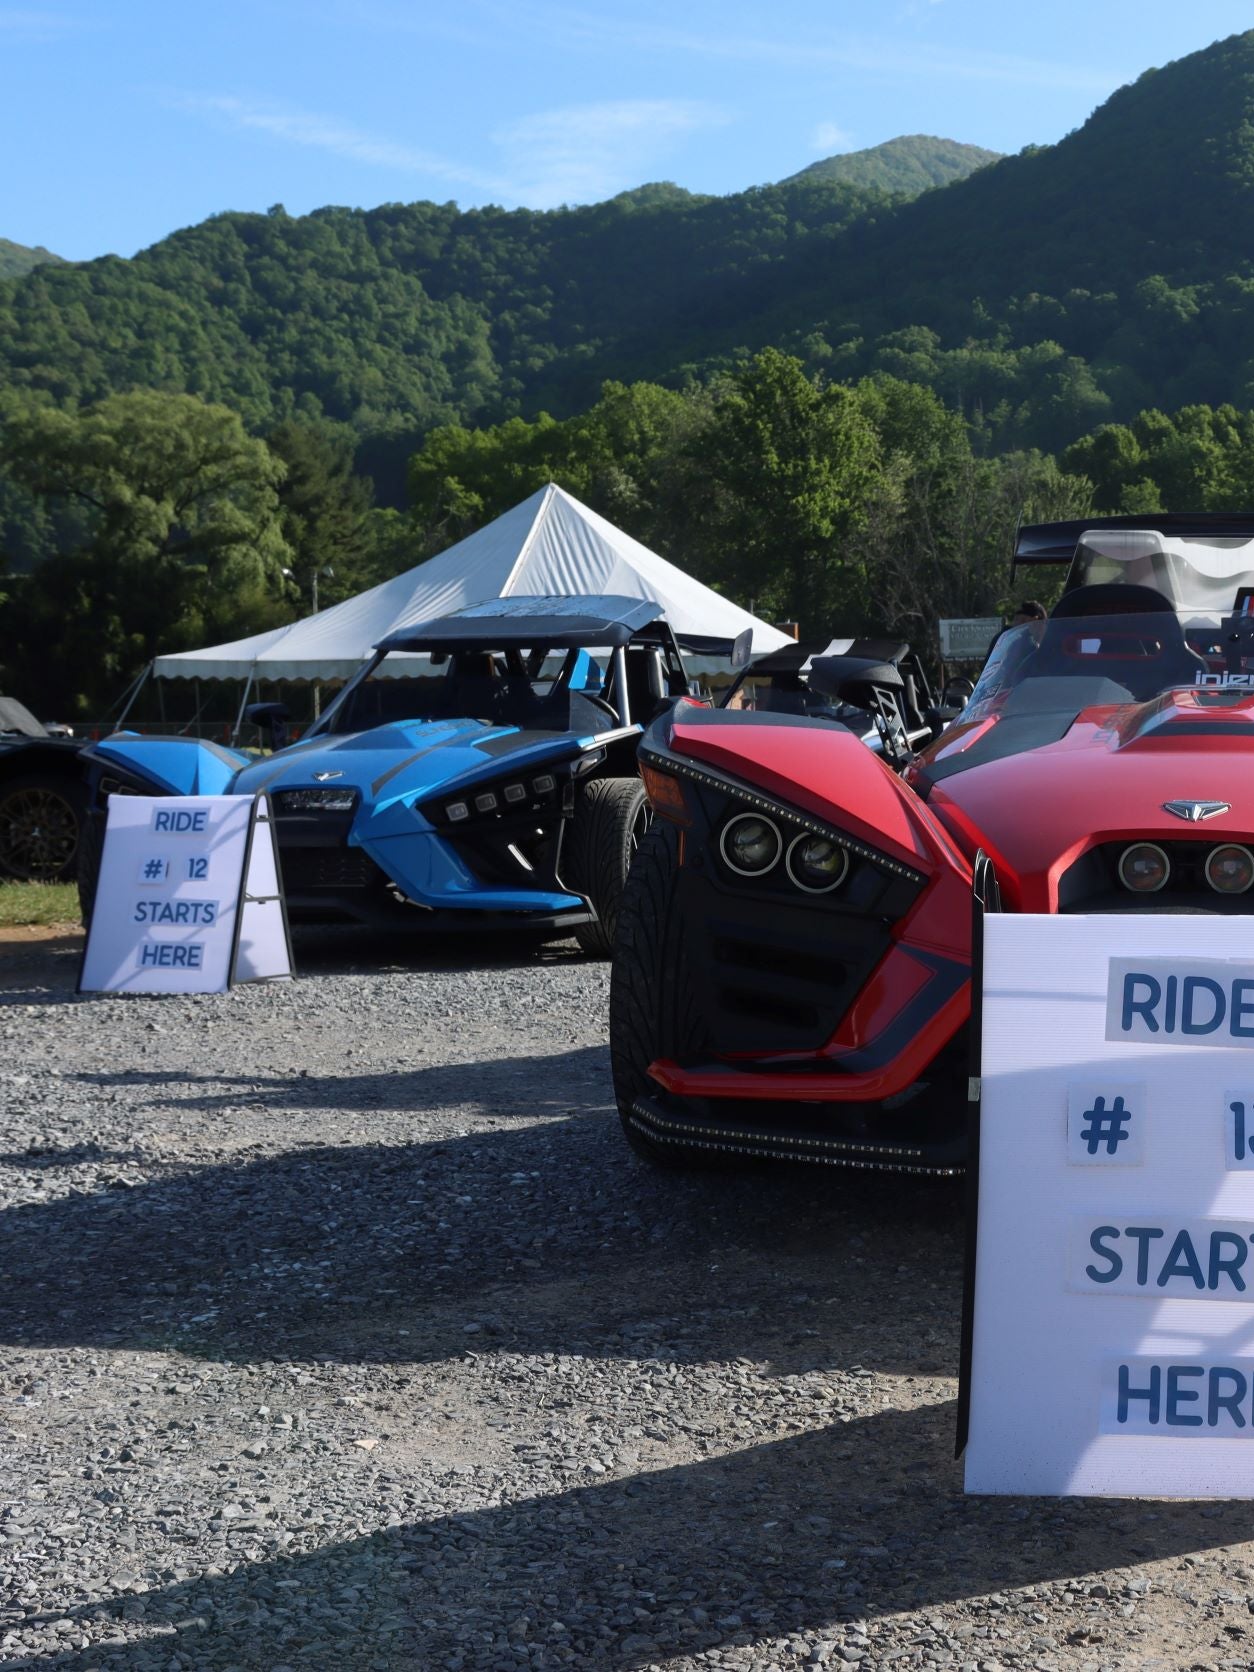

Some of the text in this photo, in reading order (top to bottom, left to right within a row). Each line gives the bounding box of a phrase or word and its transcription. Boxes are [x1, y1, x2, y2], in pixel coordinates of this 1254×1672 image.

[154, 811, 207, 832] RIDE
[144, 858, 208, 879] # 12
[133, 901, 215, 924] STARTS
[141, 944, 201, 967] HERE
[1079, 1095, 1132, 1155] #
